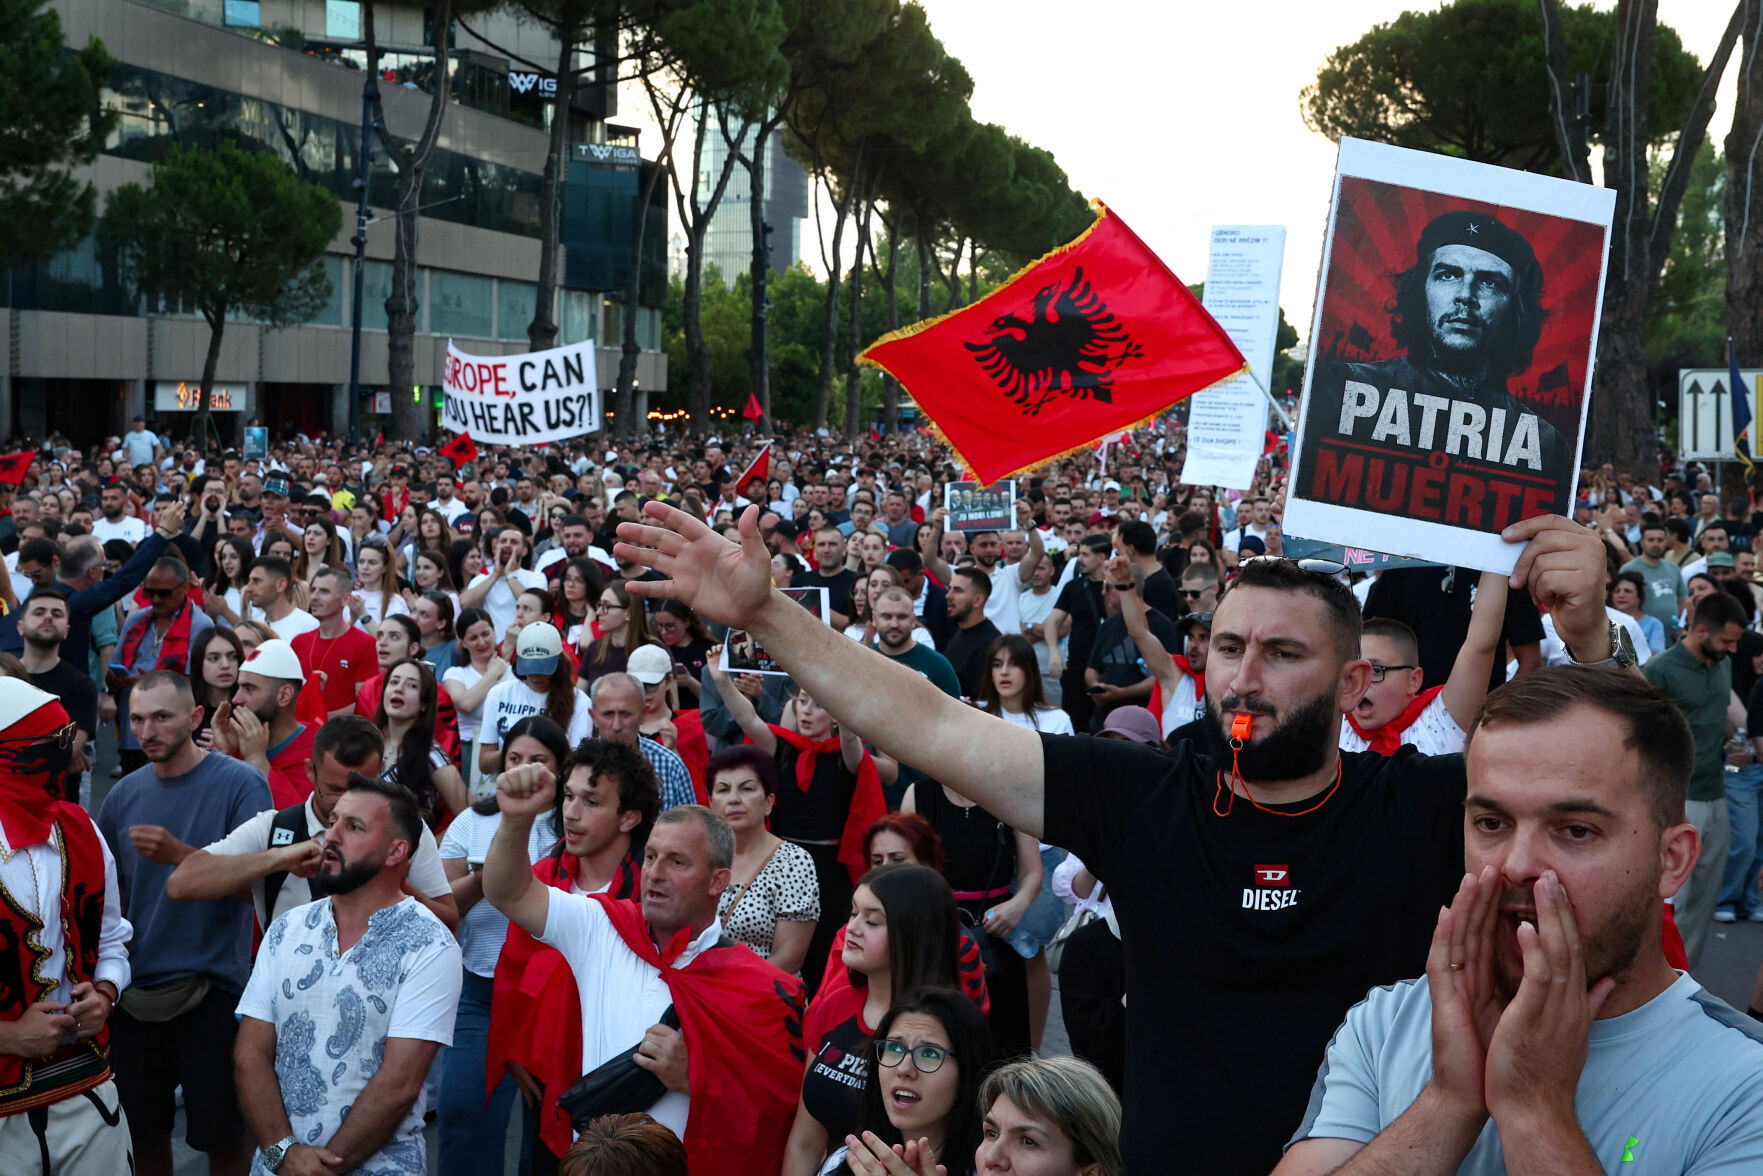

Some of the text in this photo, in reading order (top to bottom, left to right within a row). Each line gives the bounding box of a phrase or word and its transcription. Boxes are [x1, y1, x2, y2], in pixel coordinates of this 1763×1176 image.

[509, 72, 557, 94] WIG
[579, 144, 637, 160] TWIGA
[519, 353, 584, 392] CAN
[470, 400, 541, 435] HEAR
[544, 393, 593, 430] US?!
[1338, 380, 1542, 471] PATRIA
[1428, 451, 1448, 470] O
[1312, 450, 1556, 531] MUERTE
[498, 701, 536, 715] PHILIPP
[1241, 888, 1298, 911] DIESEL
[818, 1041, 868, 1077] I PIZ
